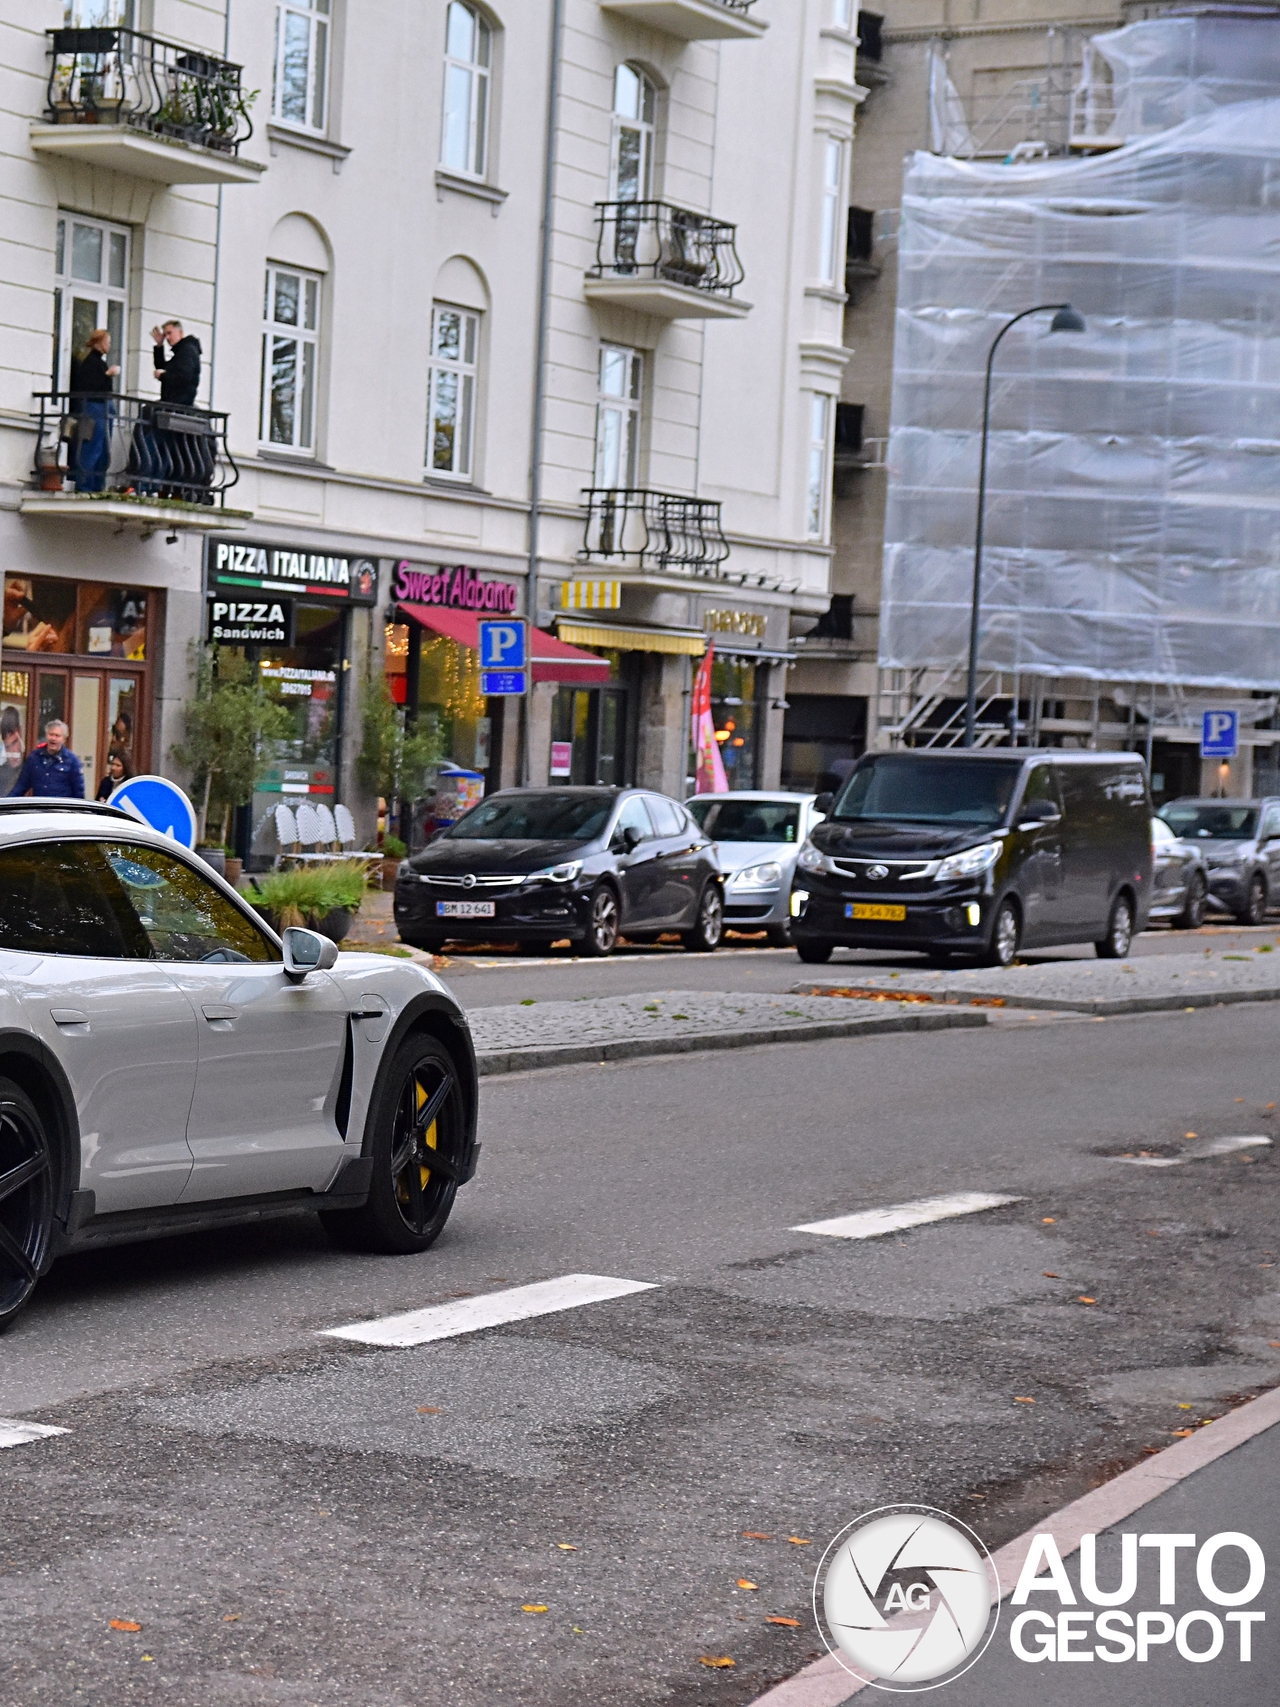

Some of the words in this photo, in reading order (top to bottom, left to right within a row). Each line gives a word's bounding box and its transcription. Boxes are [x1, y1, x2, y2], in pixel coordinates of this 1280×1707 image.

[216, 543, 269, 575] PIZZA
[273, 550, 350, 584] ITALIANA
[395, 560, 450, 604] Sweet
[450, 564, 517, 611] Alabama
[213, 602, 285, 623] PIZZA
[213, 625, 285, 641] Sandwich
[487, 627, 517, 662] P
[1208, 713, 1233, 742] P
[444, 904, 458, 914] BM
[460, 904, 472, 914] 12
[474, 904, 491, 914] 641
